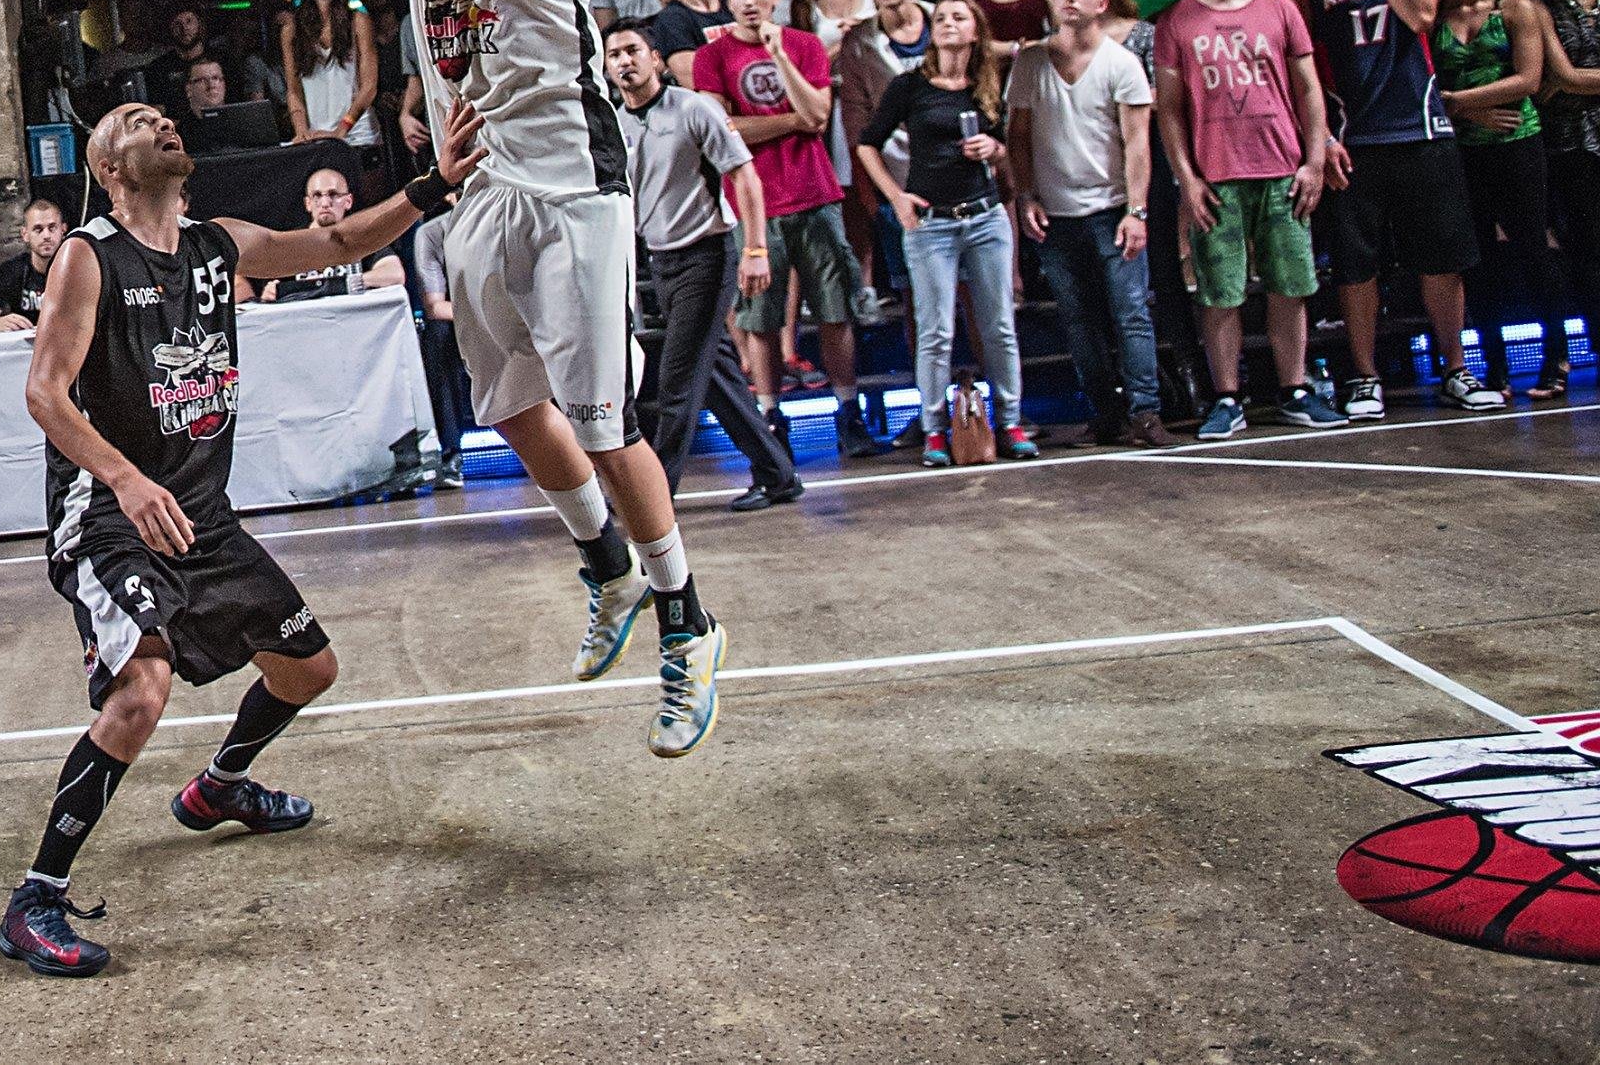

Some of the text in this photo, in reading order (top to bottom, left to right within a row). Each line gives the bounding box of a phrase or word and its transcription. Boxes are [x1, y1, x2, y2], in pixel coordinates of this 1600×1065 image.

[1349, 4, 1389, 46] 17
[1193, 30, 1273, 65] PARA
[1203, 59, 1267, 90] DISE
[123, 286, 160, 308] snipes
[192, 255, 231, 315] 55
[149, 380, 188, 408] Red
[185, 374, 216, 401] Bull
[566, 402, 607, 424] snipes
